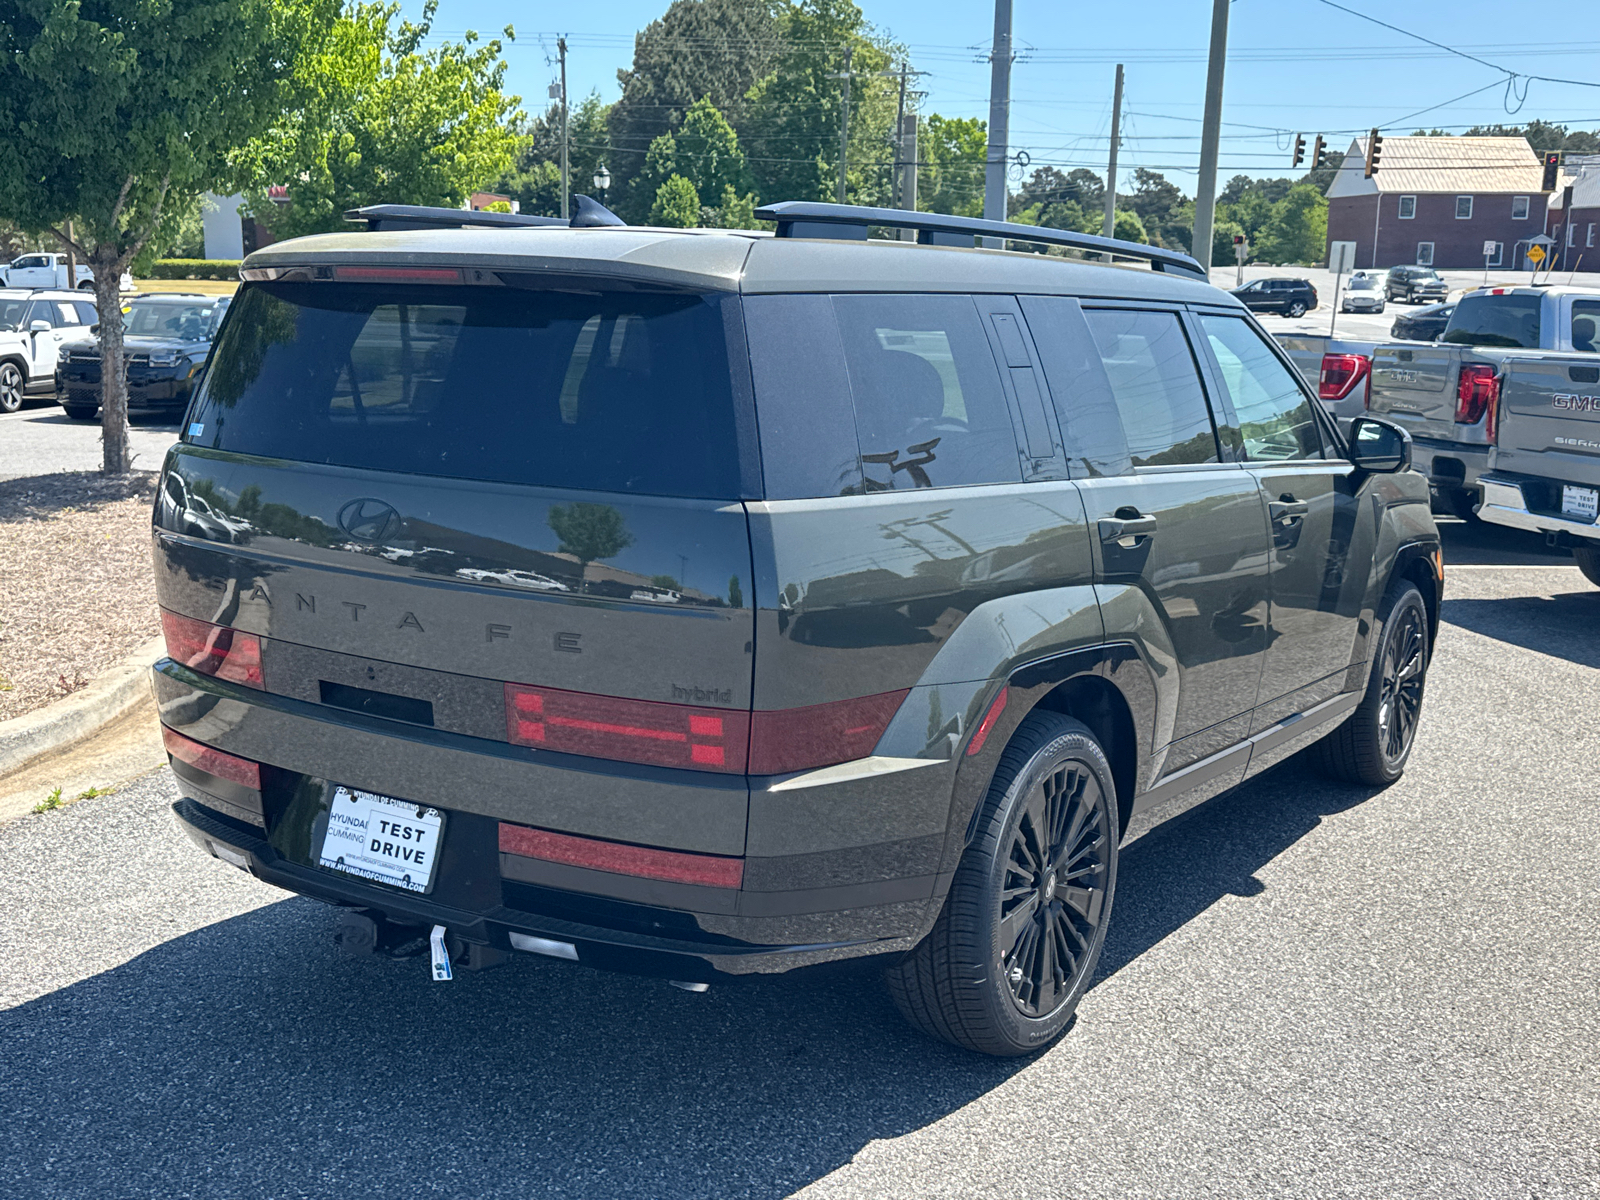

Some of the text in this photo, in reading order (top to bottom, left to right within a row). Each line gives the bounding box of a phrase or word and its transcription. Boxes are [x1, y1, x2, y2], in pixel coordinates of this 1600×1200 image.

[1552, 392, 1600, 412] GMC
[1554, 436, 1600, 448] SIERR
[1577, 502, 1595, 510] DRIVE
[1579, 495, 1595, 503] TEST
[485, 623, 582, 654] FE
[672, 683, 732, 703] hybrid
[353, 789, 420, 812] HYUNDAI OF CUMMING
[330, 812, 369, 829] HYUNDAI
[327, 826, 365, 844] CUMMING
[379, 819, 426, 843] TEST
[370, 838, 426, 865] DRIVE
[319, 859, 425, 893] WWW.HYUNDAIOFCUMMING.COM
